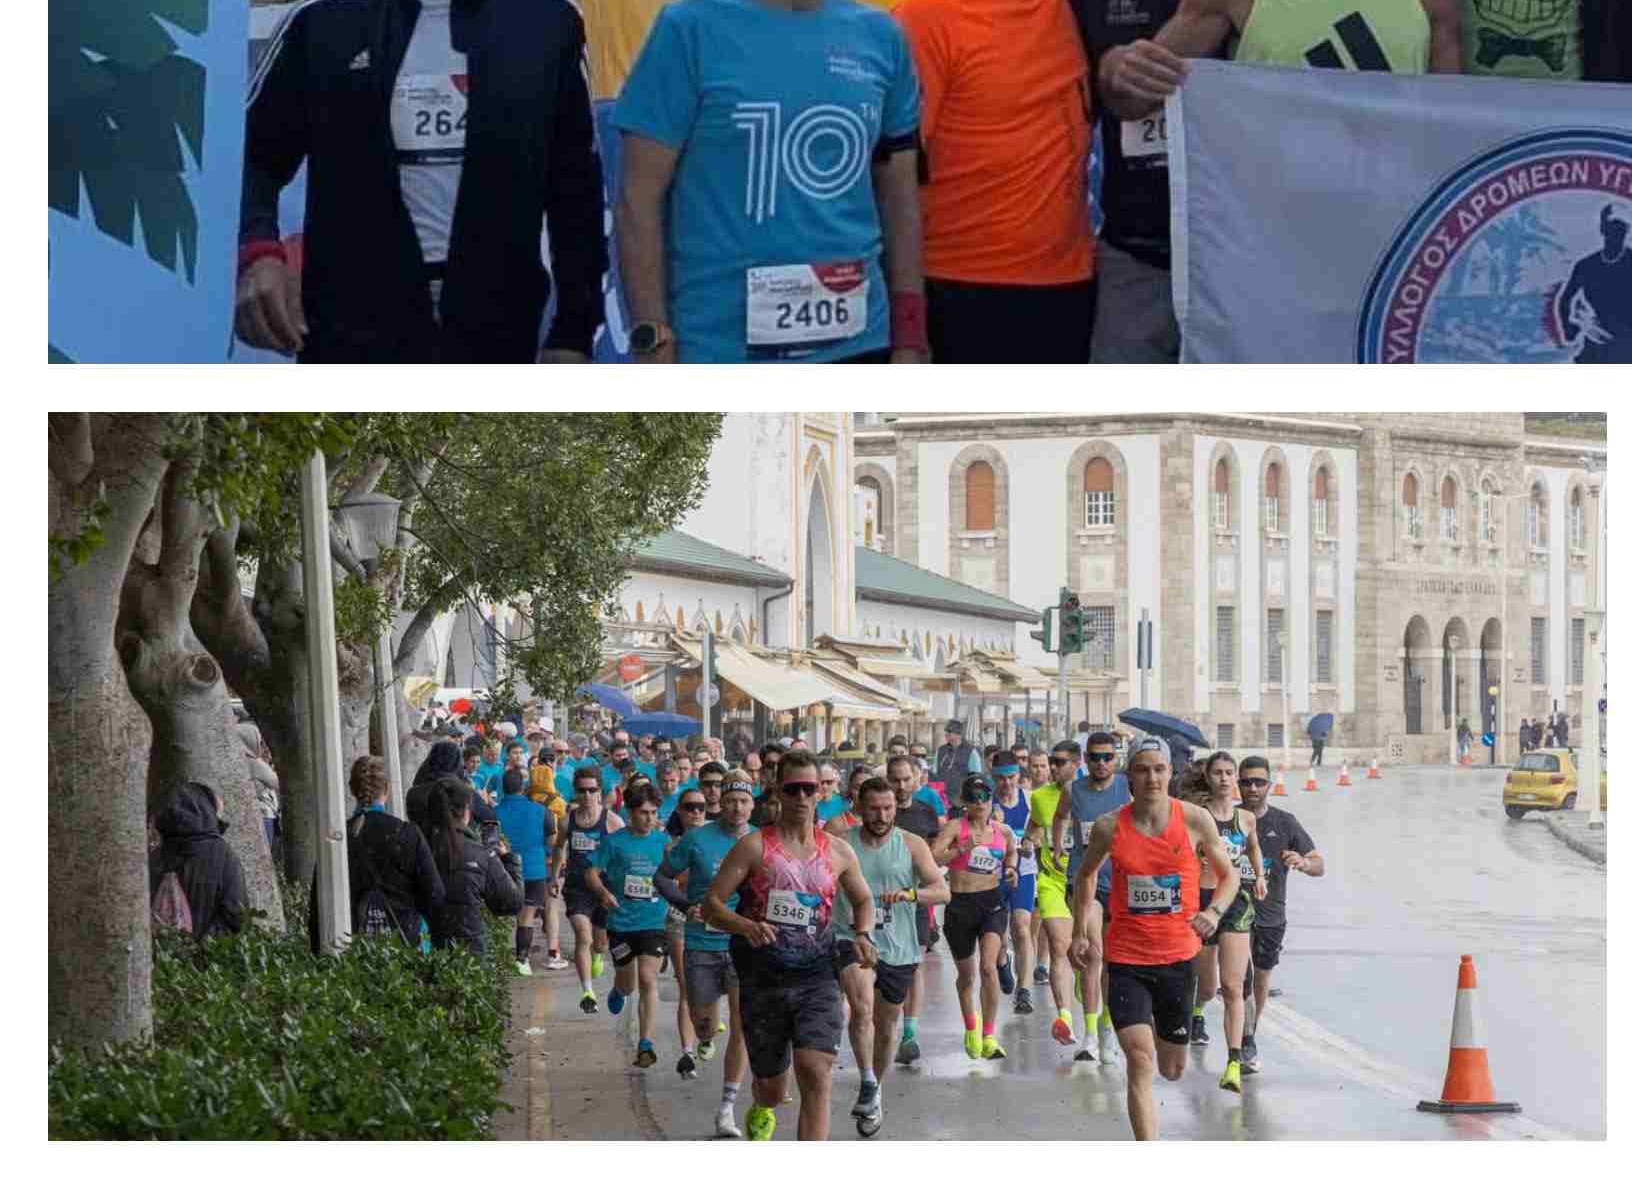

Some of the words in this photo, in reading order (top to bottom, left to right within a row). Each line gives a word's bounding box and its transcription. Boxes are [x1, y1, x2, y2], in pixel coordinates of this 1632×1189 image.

[731, 101, 869, 224] 10
[1456, 160, 1590, 235] ΔΡΟΜΕΩΝ
[776, 298, 849, 329] 2406
[1134, 889, 1166, 902] 5054
[772, 904, 805, 920] 5346
